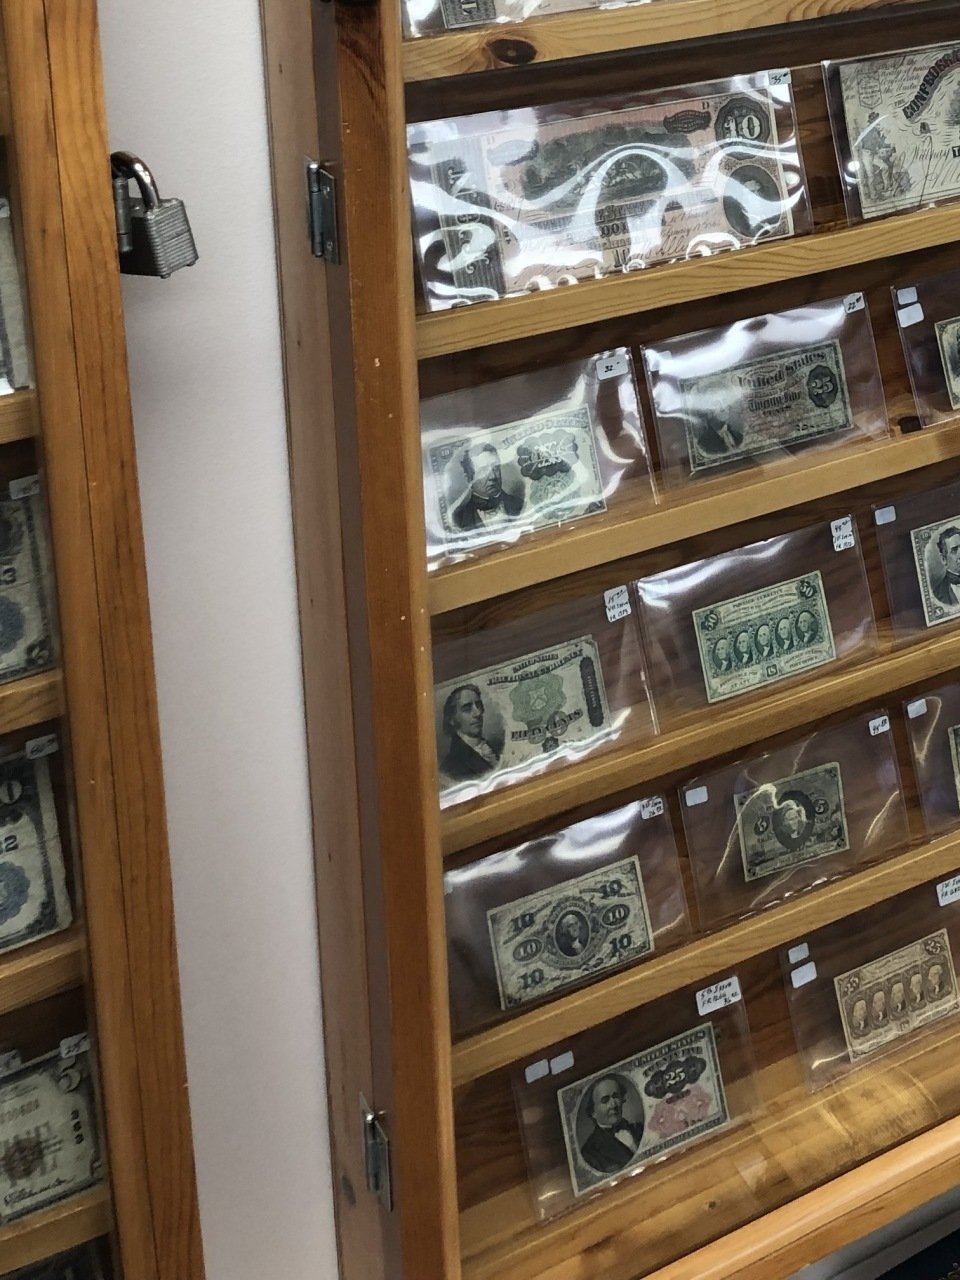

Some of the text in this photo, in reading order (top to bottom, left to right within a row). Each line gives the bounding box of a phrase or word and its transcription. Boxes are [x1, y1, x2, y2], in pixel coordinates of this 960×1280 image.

[723, 114, 761, 140] 10
[811, 376, 834, 396] 25
[606, 907, 626, 923] 10
[518, 942, 540, 959] 10
[519, 969, 545, 990] 10
[665, 1067, 687, 1089] 25
